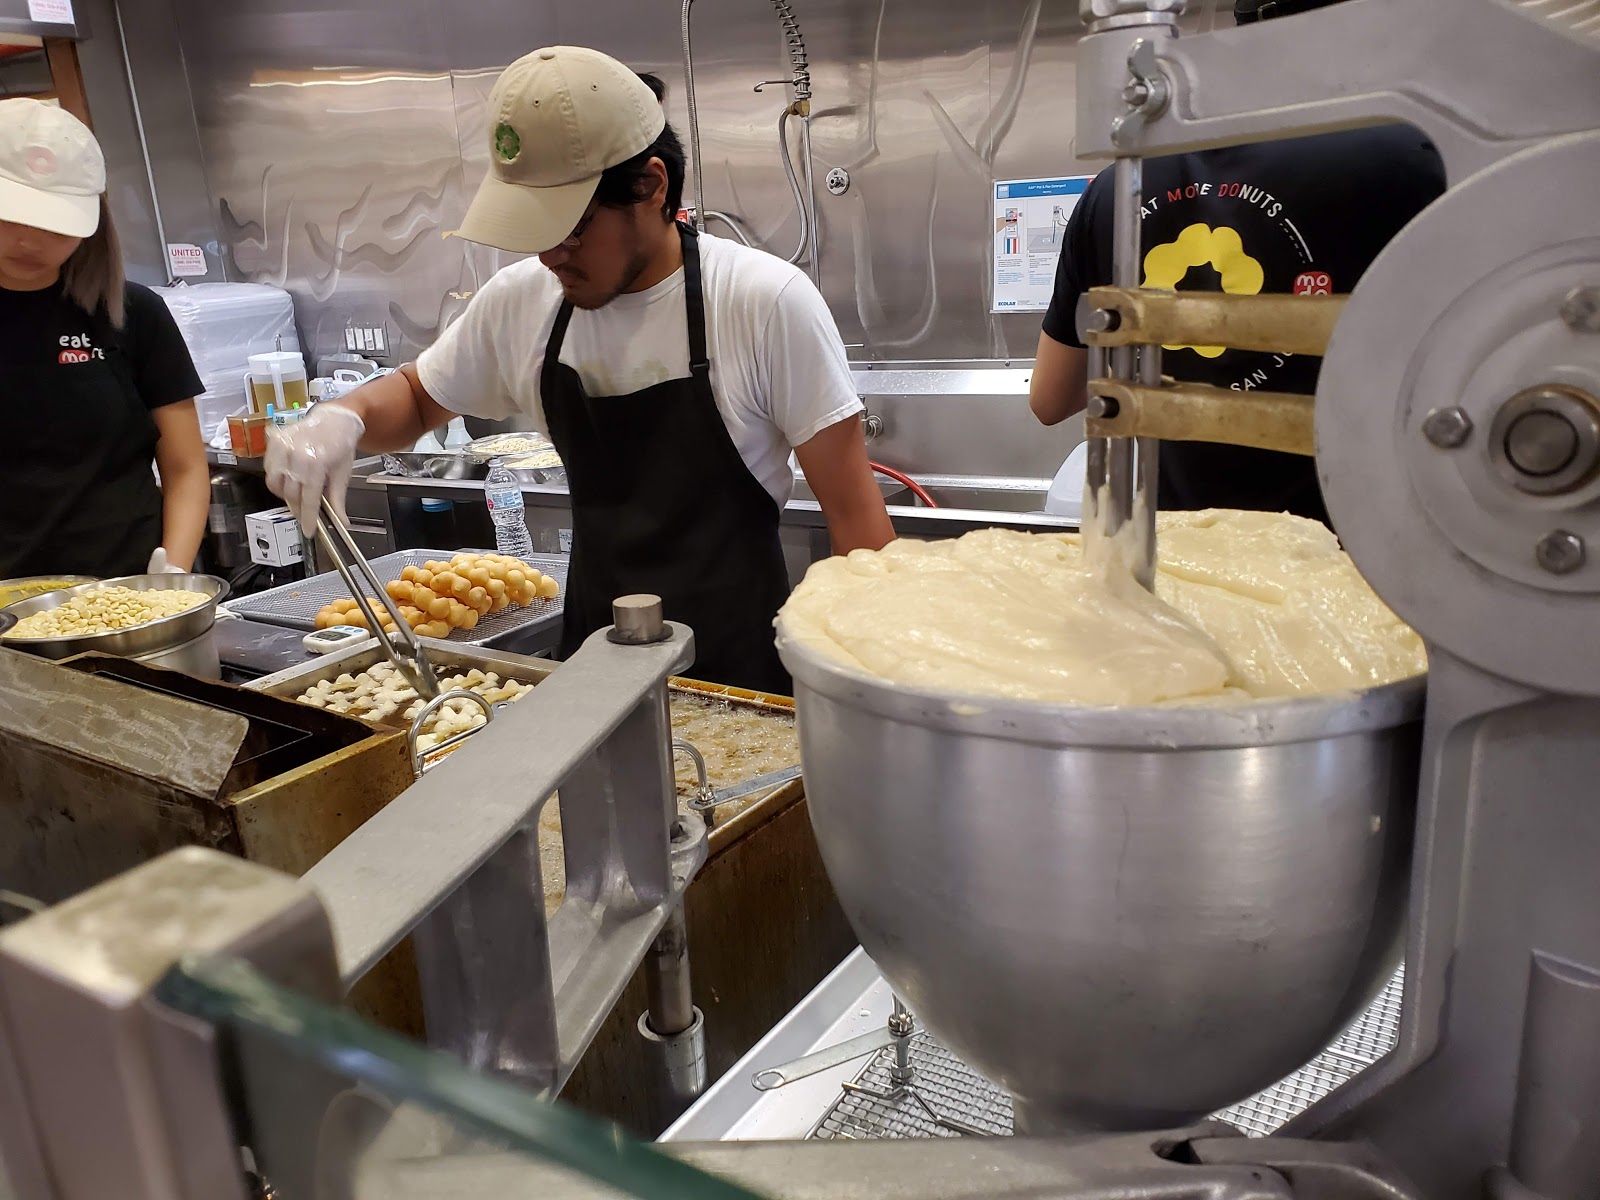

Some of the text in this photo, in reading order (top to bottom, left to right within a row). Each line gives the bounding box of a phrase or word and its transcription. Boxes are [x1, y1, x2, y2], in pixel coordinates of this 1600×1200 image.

[1140, 196, 1158, 220] AT
[1217, 182, 1283, 218] DONUTS
[171, 248, 201, 257] UNITED
[1296, 274, 1329, 287] mo
[59, 332, 92, 348] eat
[1230, 368, 1268, 392] SAN
